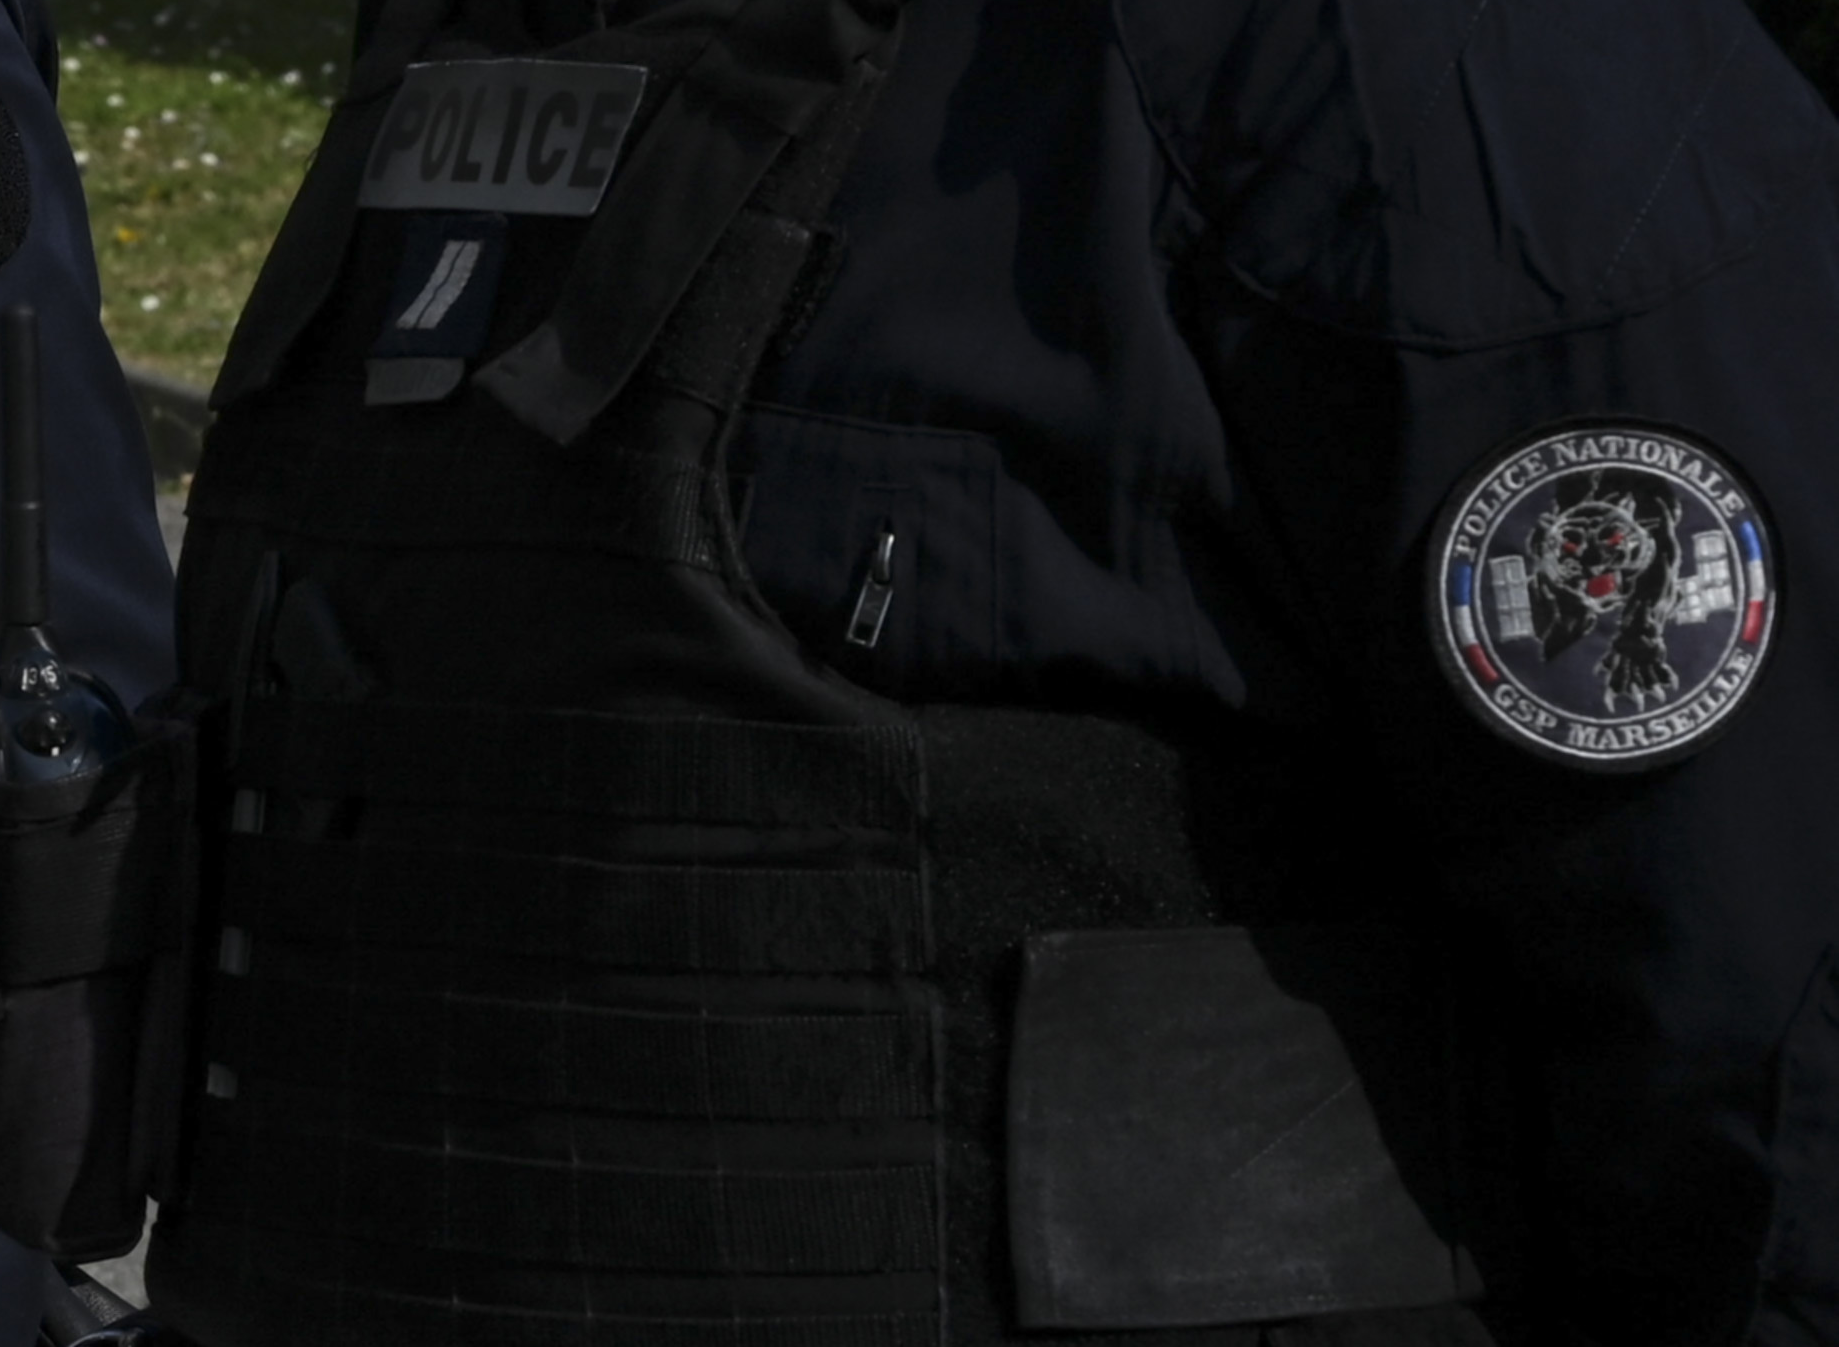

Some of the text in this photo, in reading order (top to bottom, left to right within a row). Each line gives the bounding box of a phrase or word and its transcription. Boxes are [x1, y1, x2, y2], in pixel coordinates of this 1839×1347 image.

[368, 85, 630, 189] POLICE
[1453, 434, 1746, 563] POLICE NATIONALE
[1493, 646, 1754, 751] GSP MARSEILLE
